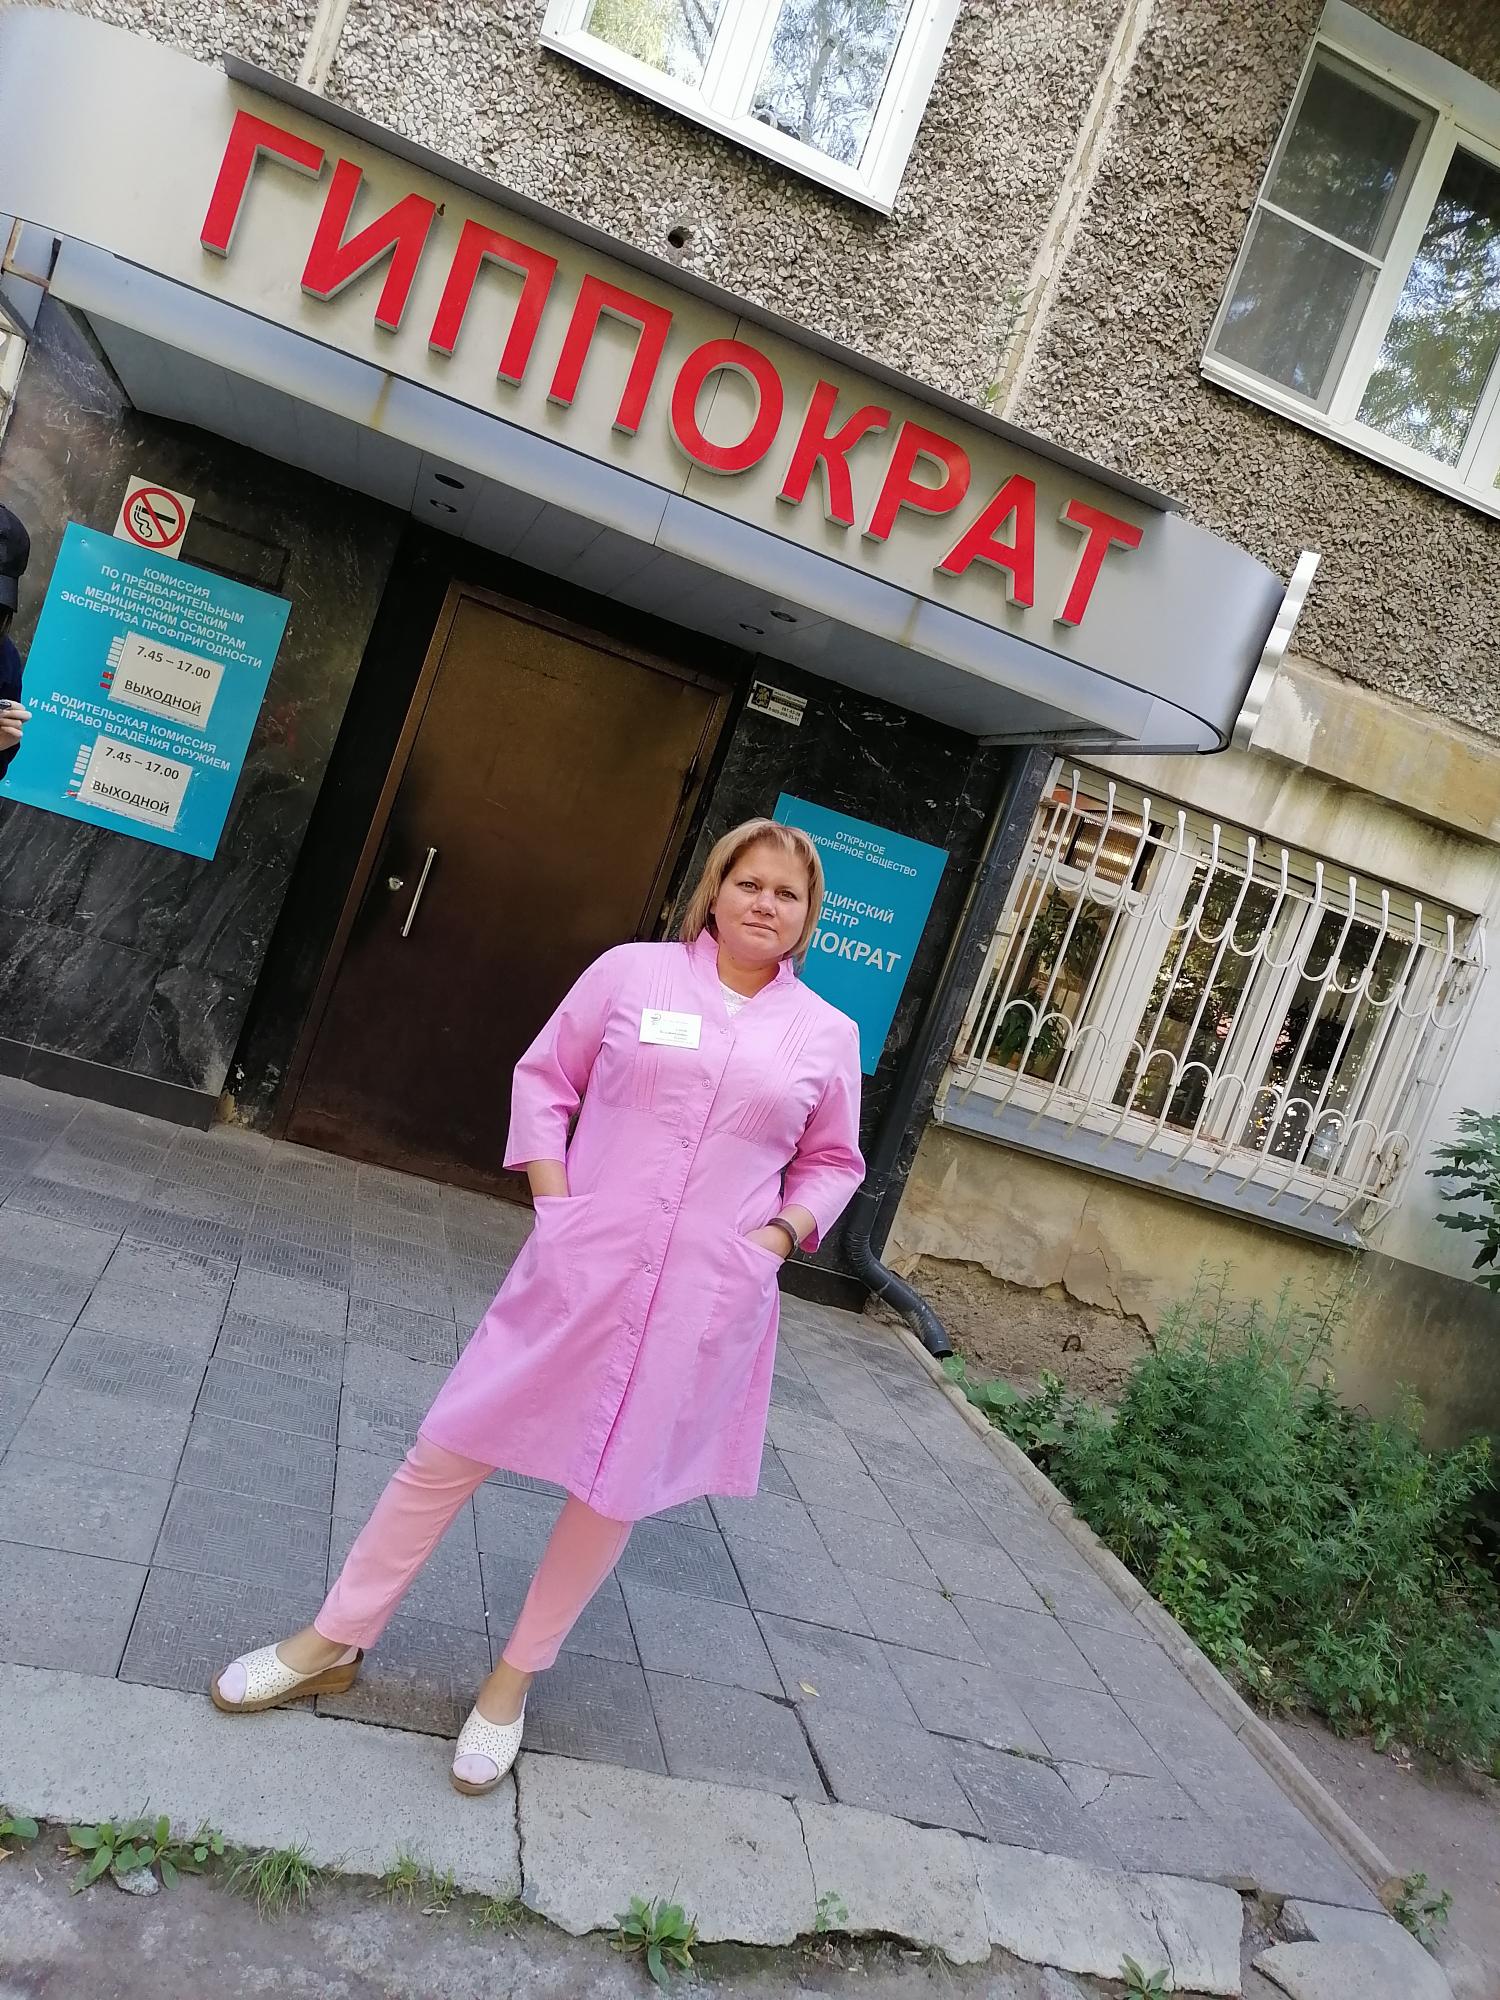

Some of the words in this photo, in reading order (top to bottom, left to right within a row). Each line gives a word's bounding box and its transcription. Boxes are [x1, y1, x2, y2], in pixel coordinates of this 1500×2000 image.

[199, 109, 1143, 627] ГИППОКРАТ
[101, 565, 118, 579] ПО
[121, 572, 244, 624] ПРЕДВАРИТЕЛЬНЫМ
[143, 567, 211, 598] КОМИССИЯ
[85, 586, 177, 626] МЕДИЦИНСКИМ
[180, 616, 247, 650] ОСМОТРАМ
[111, 582, 121, 593] И
[123, 586, 228, 631] ПЕРИОДИЧЕСКИМ
[60, 590, 139, 626] ЭКСПЕРТИЗА
[142, 618, 263, 668] ПРОФПРИГОДНОСТИ
[136, 645, 164, 663] 7.45
[176, 660, 211, 680] 17.00
[124, 680, 202, 714] ВЫХОДНОЙ
[28, 697, 38, 708] И
[40, 701, 58, 715] НА
[61, 708, 101, 728] ПРАВО
[104, 722, 170, 755] ВЛАДЕНИЯ
[172, 745, 231, 772] ОРУЖИЕМ
[51, 692, 149, 732] ВОДИТЕЛЬСКАЯ
[151, 724, 217, 754] КОМИССИЯ
[105, 746, 132, 764] 7.45
[145, 761, 180, 780] 17.00
[92, 780, 170, 814] ВЫХОДНОЙ
[835, 831, 886, 855] ОТКРЫТОЕ
[866, 853, 917, 877] ОБЩЕСТВО
